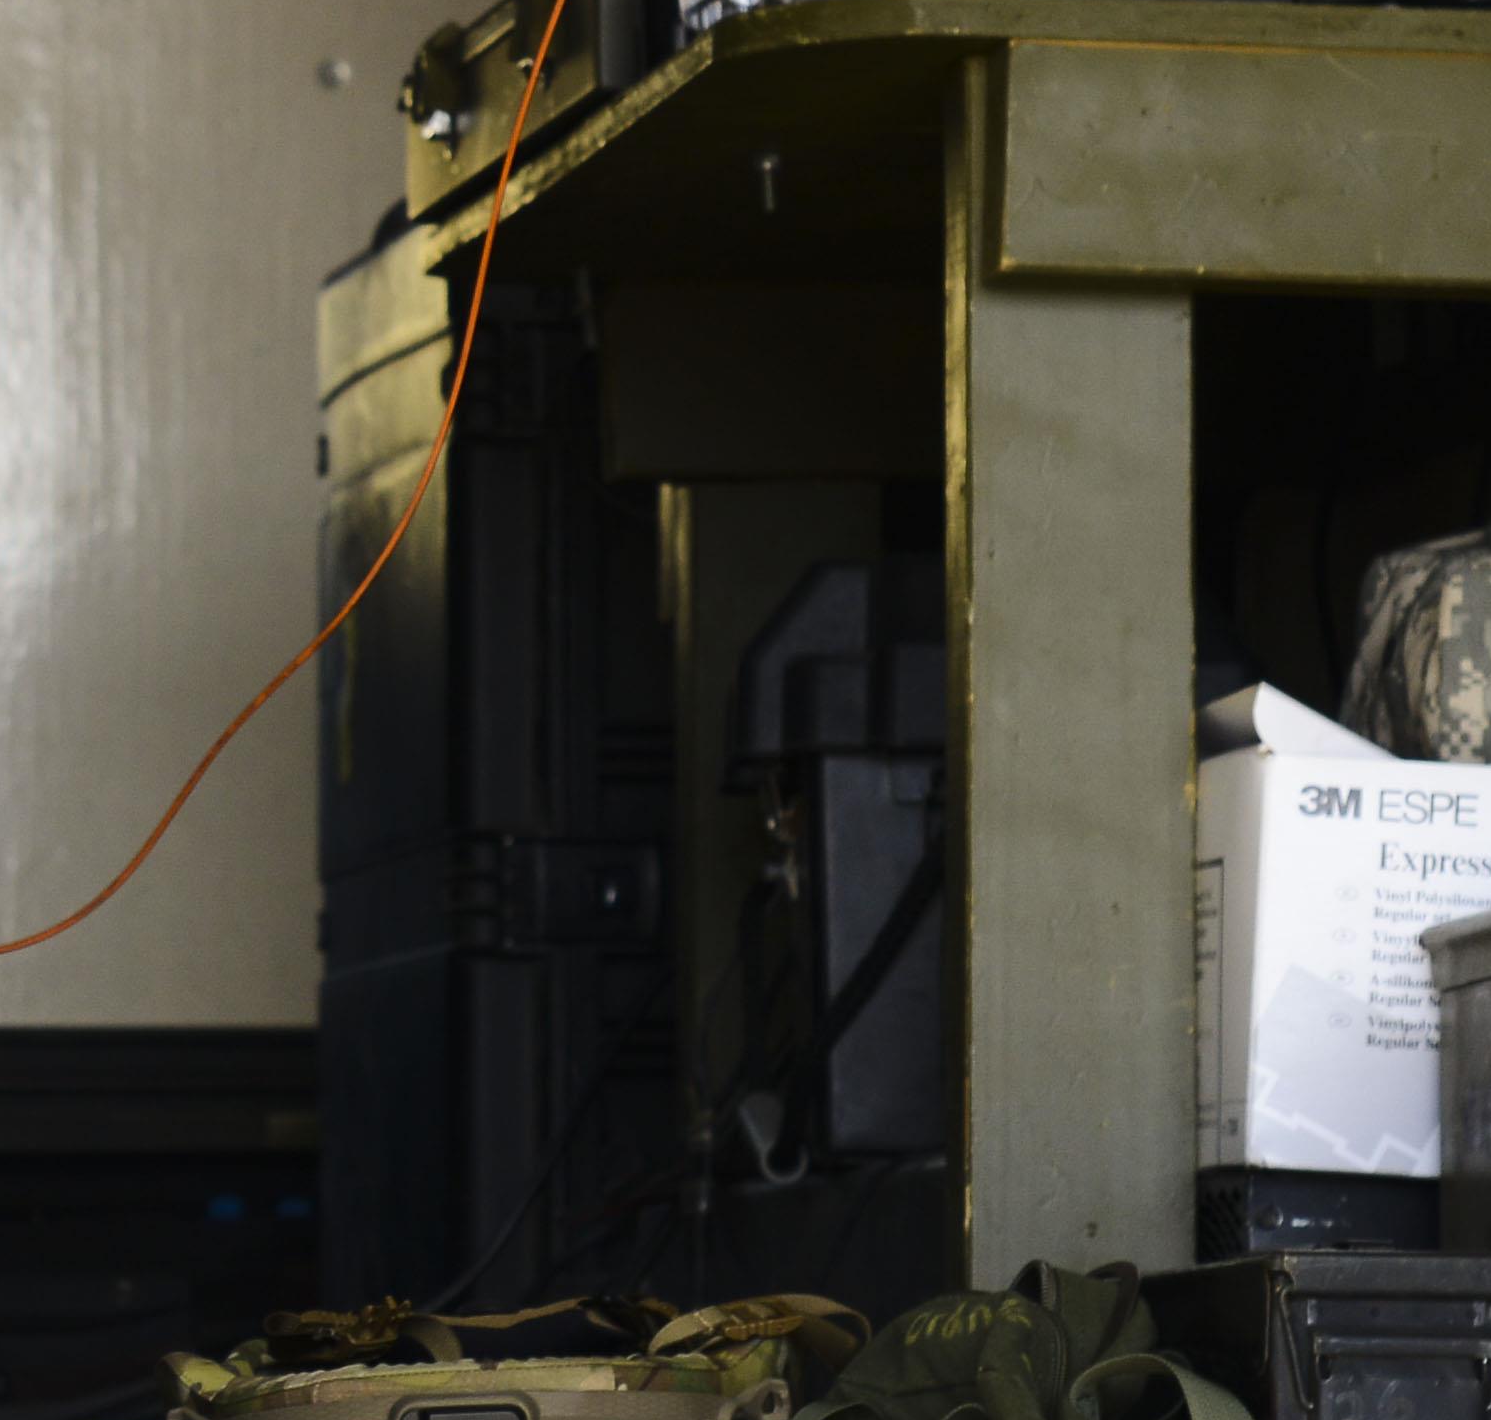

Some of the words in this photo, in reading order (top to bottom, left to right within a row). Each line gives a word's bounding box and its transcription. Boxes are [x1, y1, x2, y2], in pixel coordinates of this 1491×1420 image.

[1298, 785, 1363, 820] 3M
[1377, 788, 1480, 828] ESPE
[1372, 906, 1428, 925] Regular
[1370, 948, 1426, 968] Regular
[1367, 991, 1424, 1009] Regular
[1364, 1033, 1421, 1053] Regular
